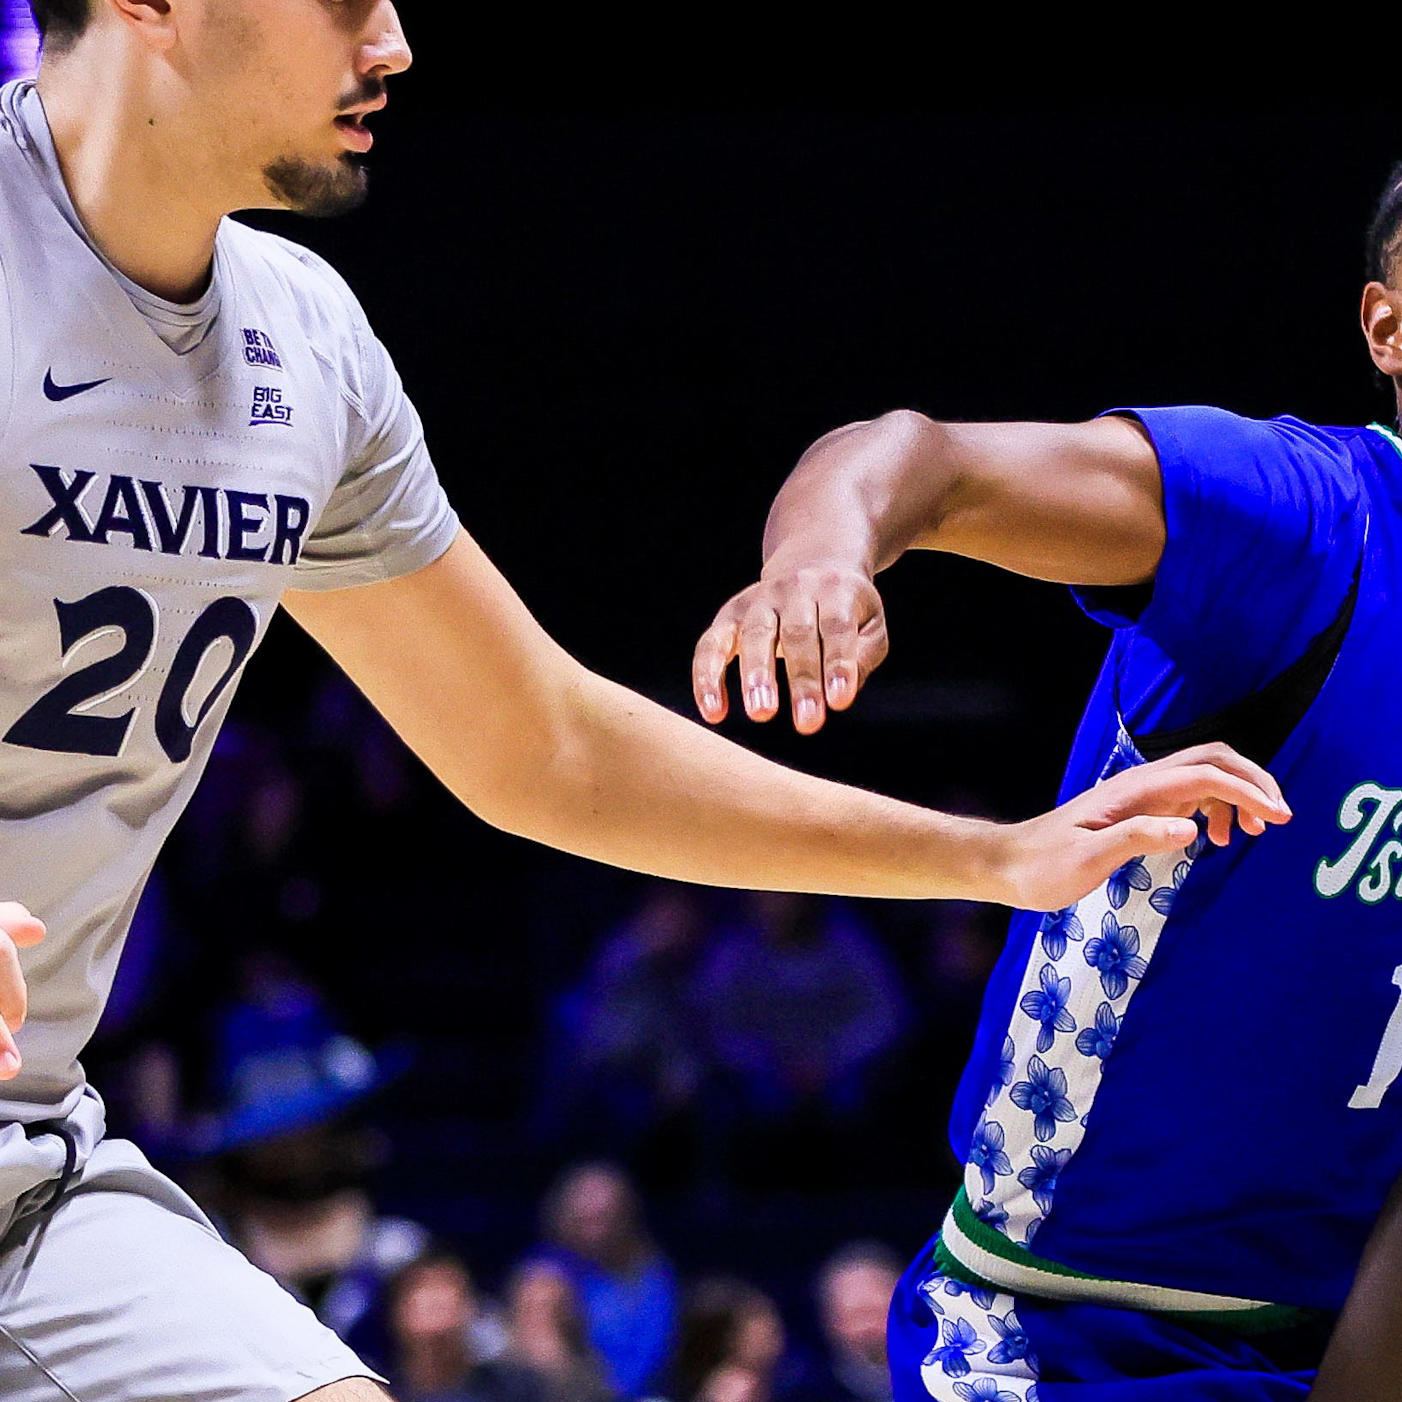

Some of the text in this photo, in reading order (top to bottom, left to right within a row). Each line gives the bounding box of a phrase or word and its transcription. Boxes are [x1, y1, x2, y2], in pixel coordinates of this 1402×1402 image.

[243, 328, 260, 345] BE
[254, 386, 282, 403] BIG
[251, 403, 293, 421] EAST
[21, 463, 310, 565] XAVIER
[2, 585, 261, 764] 20
